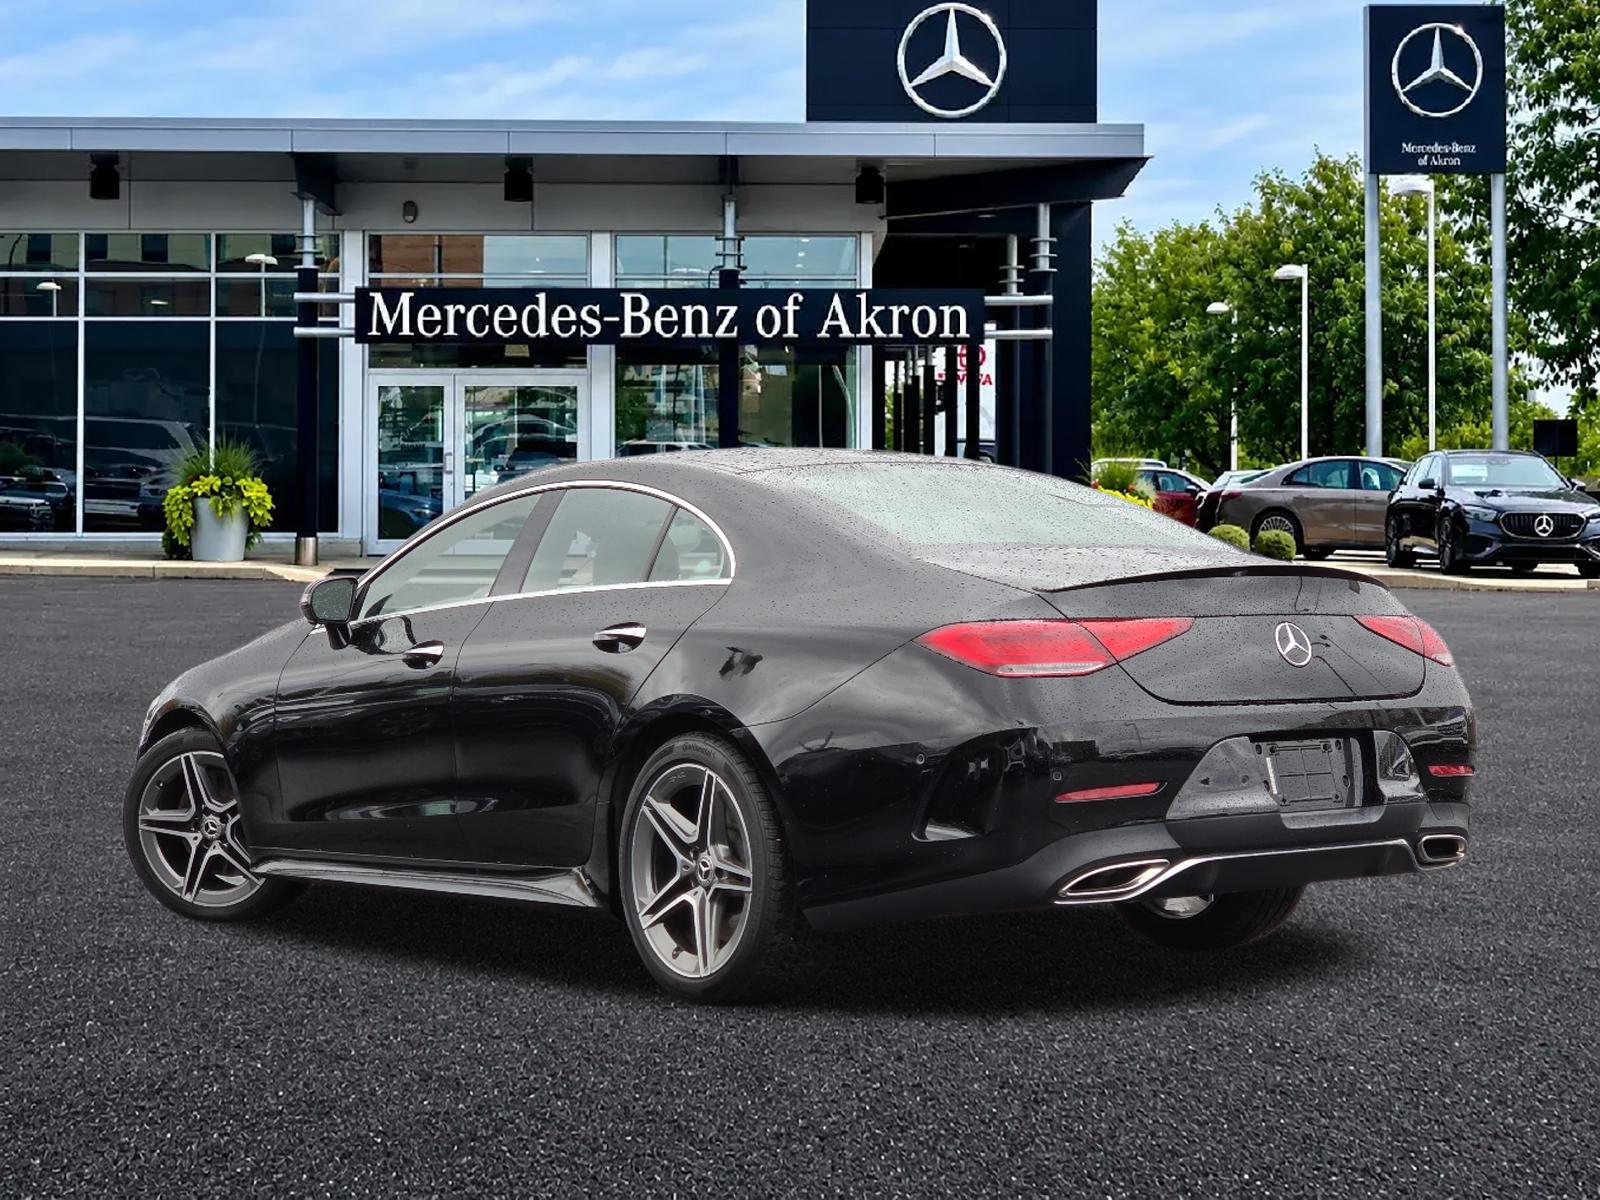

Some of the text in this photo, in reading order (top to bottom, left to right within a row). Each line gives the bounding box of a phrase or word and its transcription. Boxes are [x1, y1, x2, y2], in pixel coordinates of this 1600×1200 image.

[1401, 141, 1477, 154] Mercedes-Benz
[1417, 154, 1461, 166] of Akron
[367, 291, 970, 339] Mercedes-Benz of Akron
